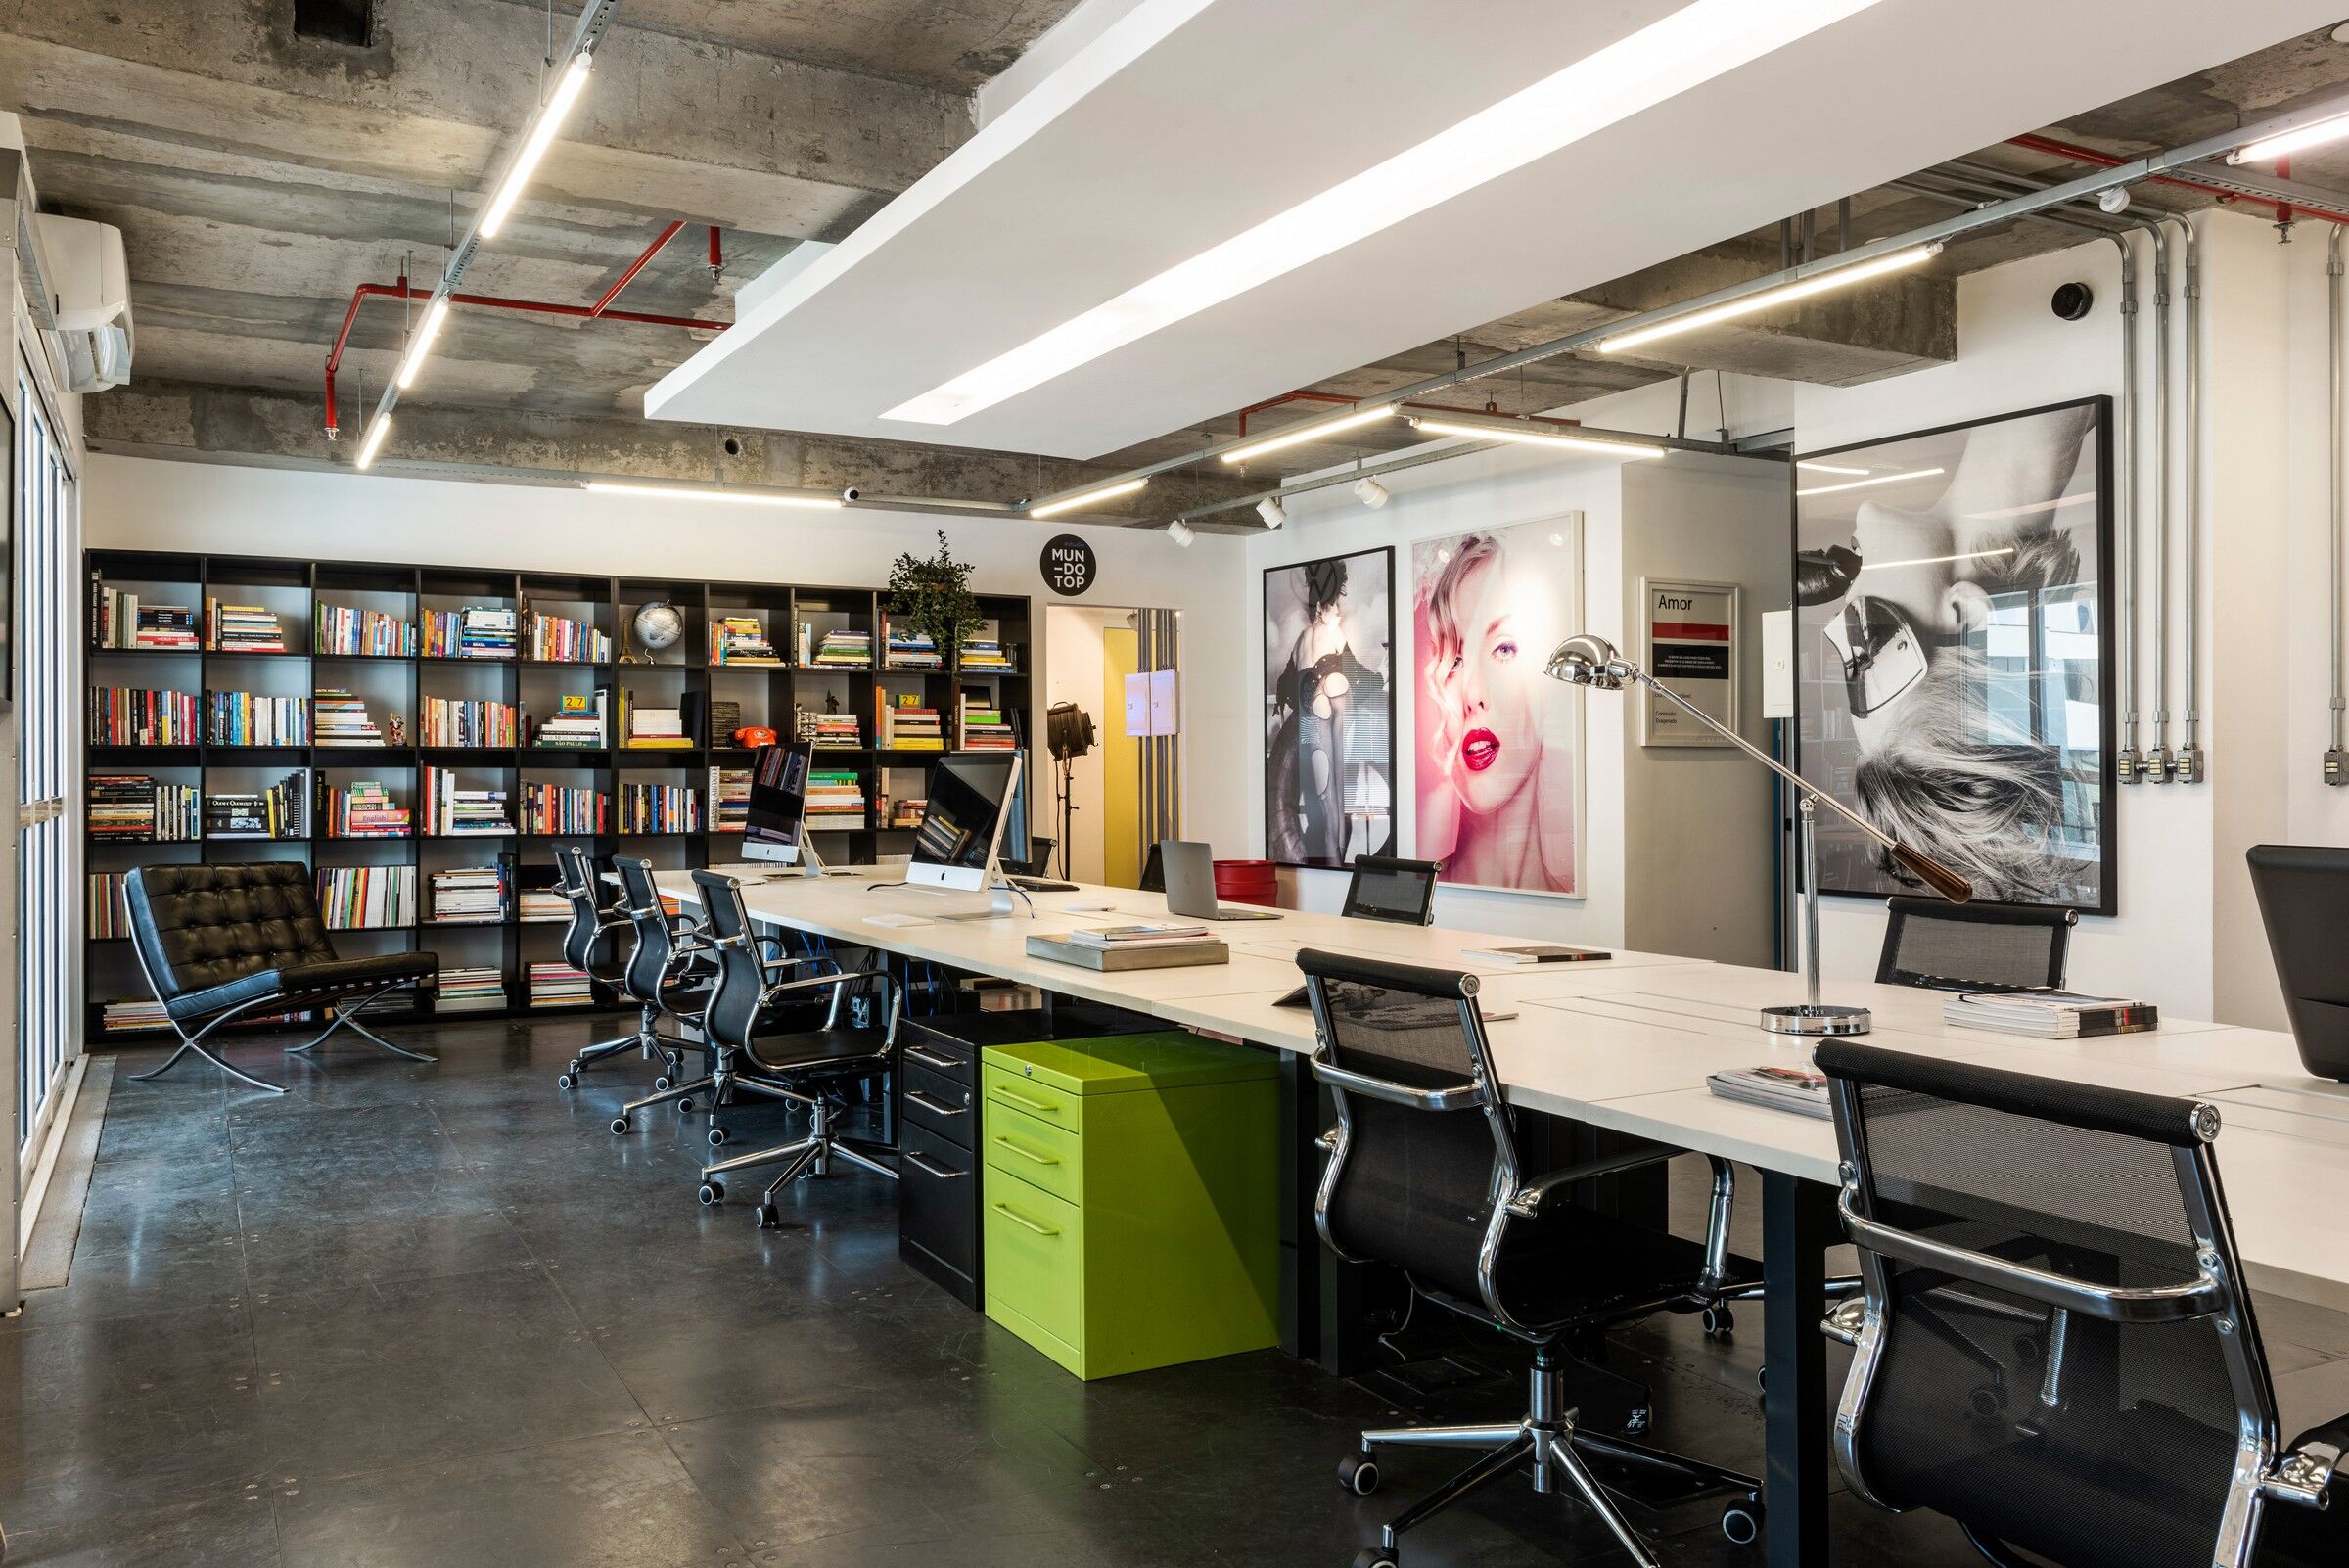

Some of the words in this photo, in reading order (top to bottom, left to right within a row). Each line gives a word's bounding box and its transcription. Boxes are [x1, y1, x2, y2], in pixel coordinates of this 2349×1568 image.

[1052, 548, 1084, 562] MUN
[1054, 576, 1085, 588] TOP
[1658, 594, 1693, 611] Amor
